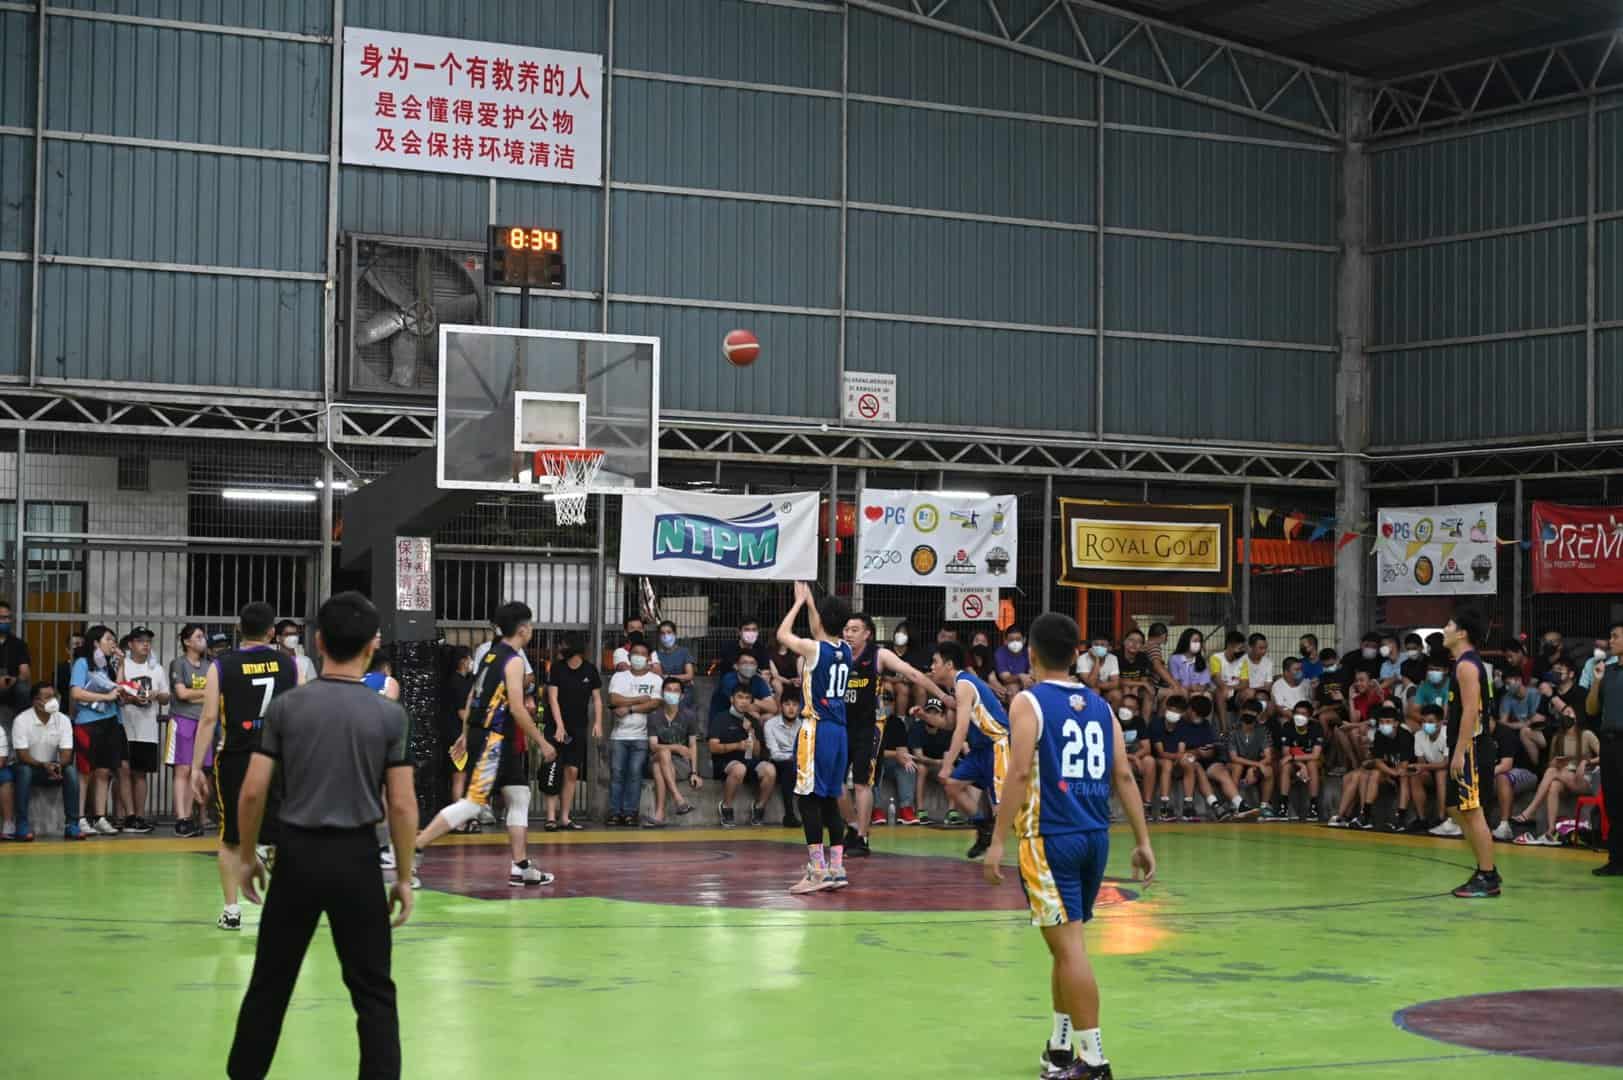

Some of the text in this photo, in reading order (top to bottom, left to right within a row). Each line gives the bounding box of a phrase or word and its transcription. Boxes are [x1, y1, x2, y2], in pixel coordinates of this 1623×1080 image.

[360, 43, 590, 99] 身为一个有教养的人
[375, 91, 574, 135] 是会懂得爱护公物
[375, 127, 575, 170] 及会保持环境清洁
[511, 228, 557, 250] 8:34
[885, 506, 905, 525] PG
[1394, 522, 1410, 540] PG
[656, 519, 776, 566] NTPM
[252, 677, 274, 717] 7
[826, 664, 848, 697] 10
[1062, 718, 1105, 779] 28
